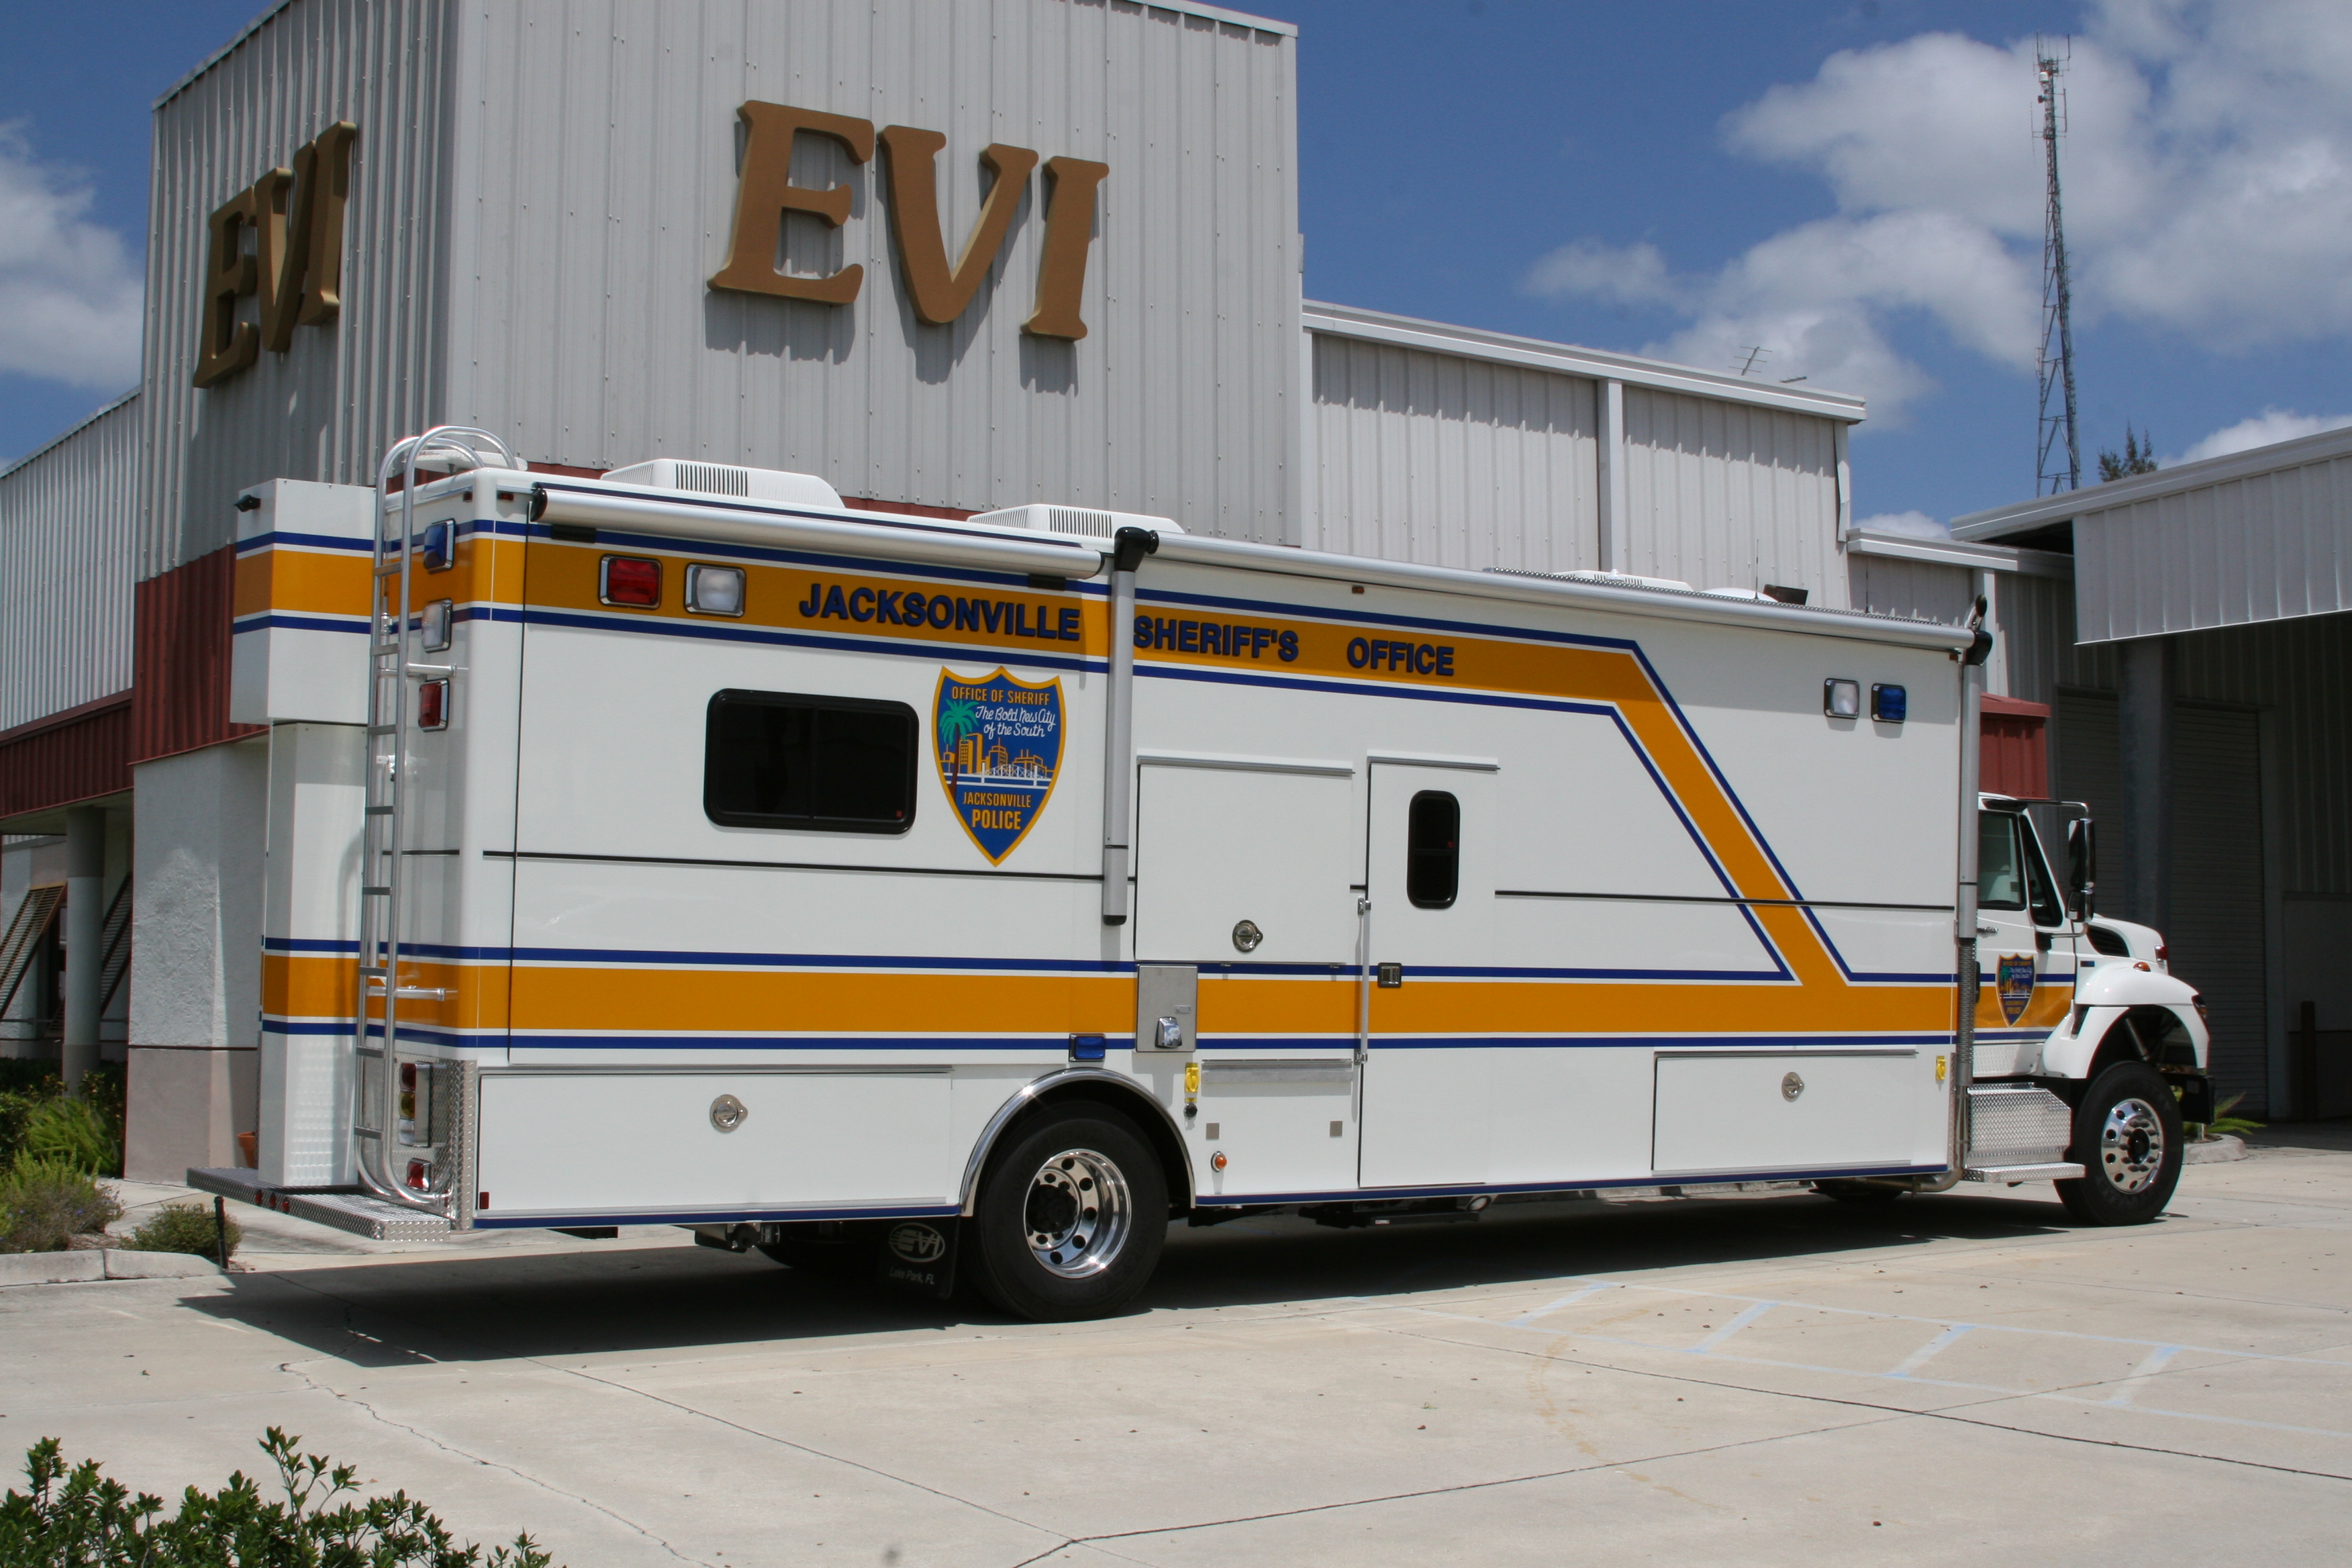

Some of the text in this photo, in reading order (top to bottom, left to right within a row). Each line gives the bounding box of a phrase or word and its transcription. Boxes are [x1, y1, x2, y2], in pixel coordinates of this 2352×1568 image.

[707, 99, 1110, 342] EVI
[193, 121, 356, 389] EVI
[799, 583, 1455, 677] JACKSONVILLE SHERIFF'S OFFICE
[952, 686, 1050, 705] OFFICE OF SHERIFF
[975, 705, 1056, 732] The Bold New City
[983, 722, 1045, 740] of the South
[963, 791, 1032, 808] JACKSONVILLE
[972, 809, 1022, 830] POLICE
[926, 1273, 935, 1285] FL
